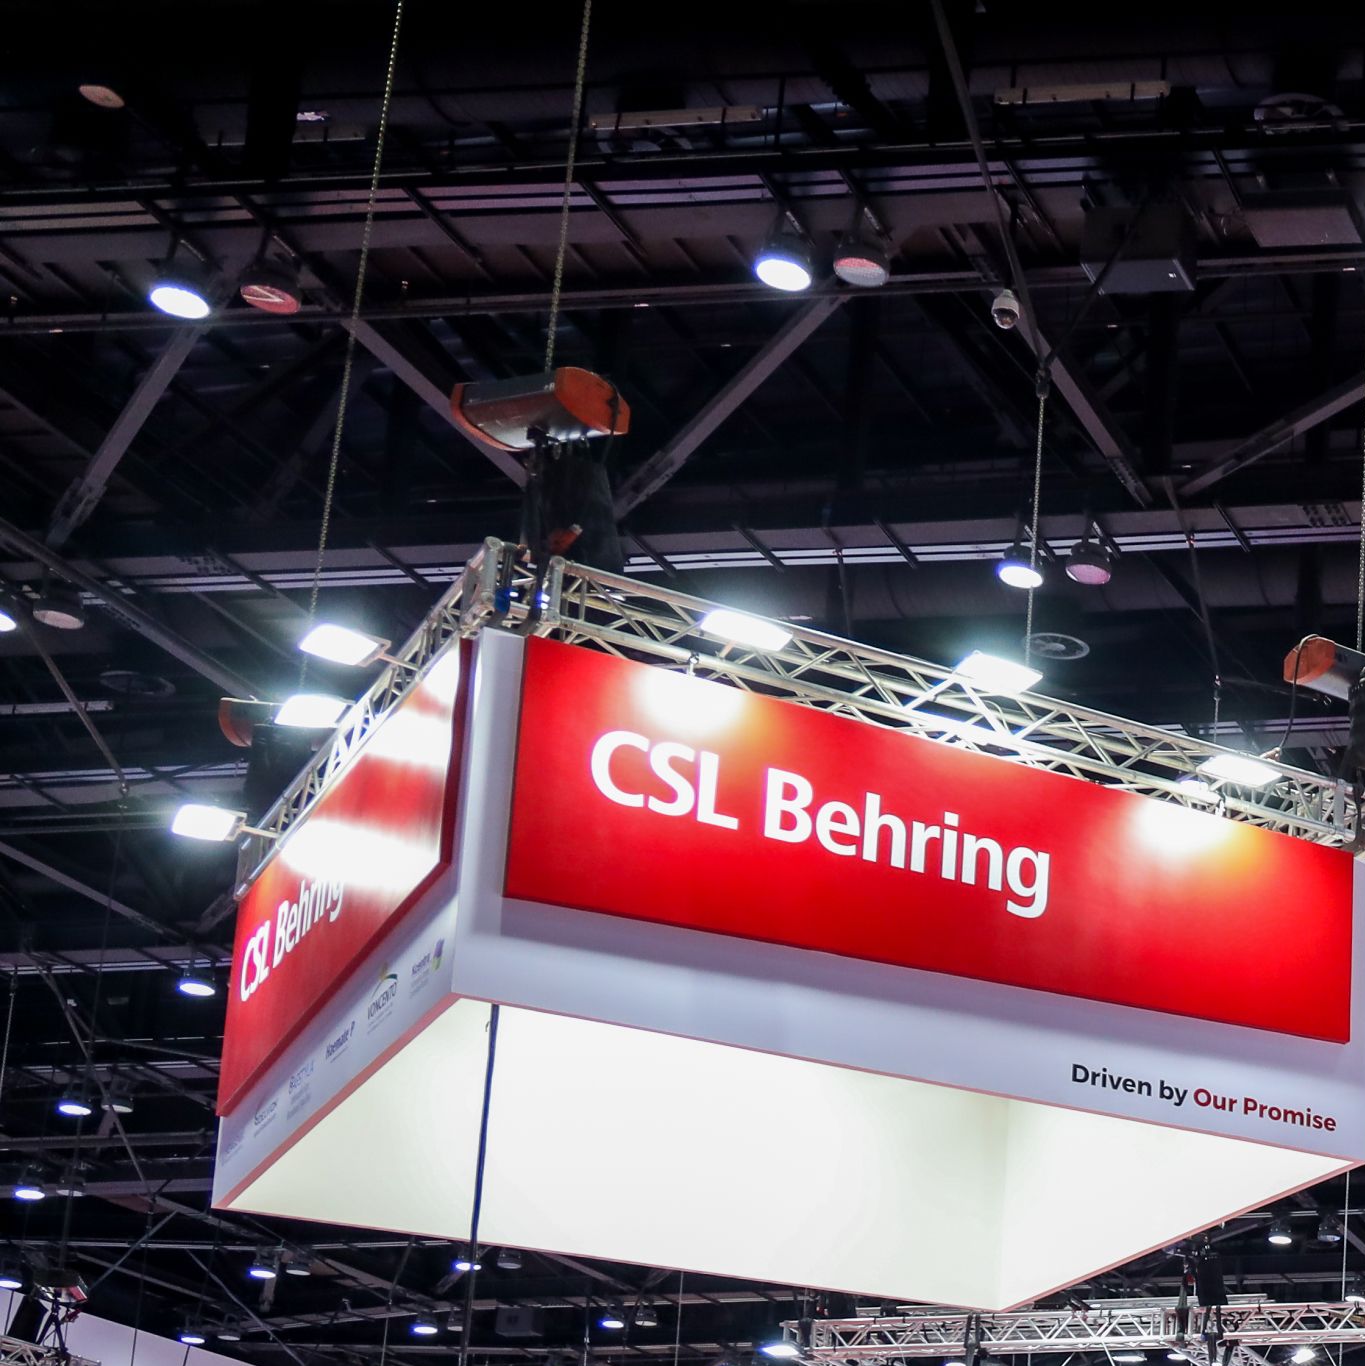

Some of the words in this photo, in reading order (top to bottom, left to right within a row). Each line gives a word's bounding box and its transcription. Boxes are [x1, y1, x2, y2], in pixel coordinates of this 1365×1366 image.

[590, 729, 740, 832] CSL
[763, 769, 1051, 920] Behring
[240, 920, 271, 1002] CSL
[272, 879, 345, 969] Behring
[1071, 1063, 1152, 1097] Driven
[1159, 1080, 1189, 1107] by
[1193, 1088, 1238, 1112] Our
[1243, 1097, 1337, 1132] Promise
